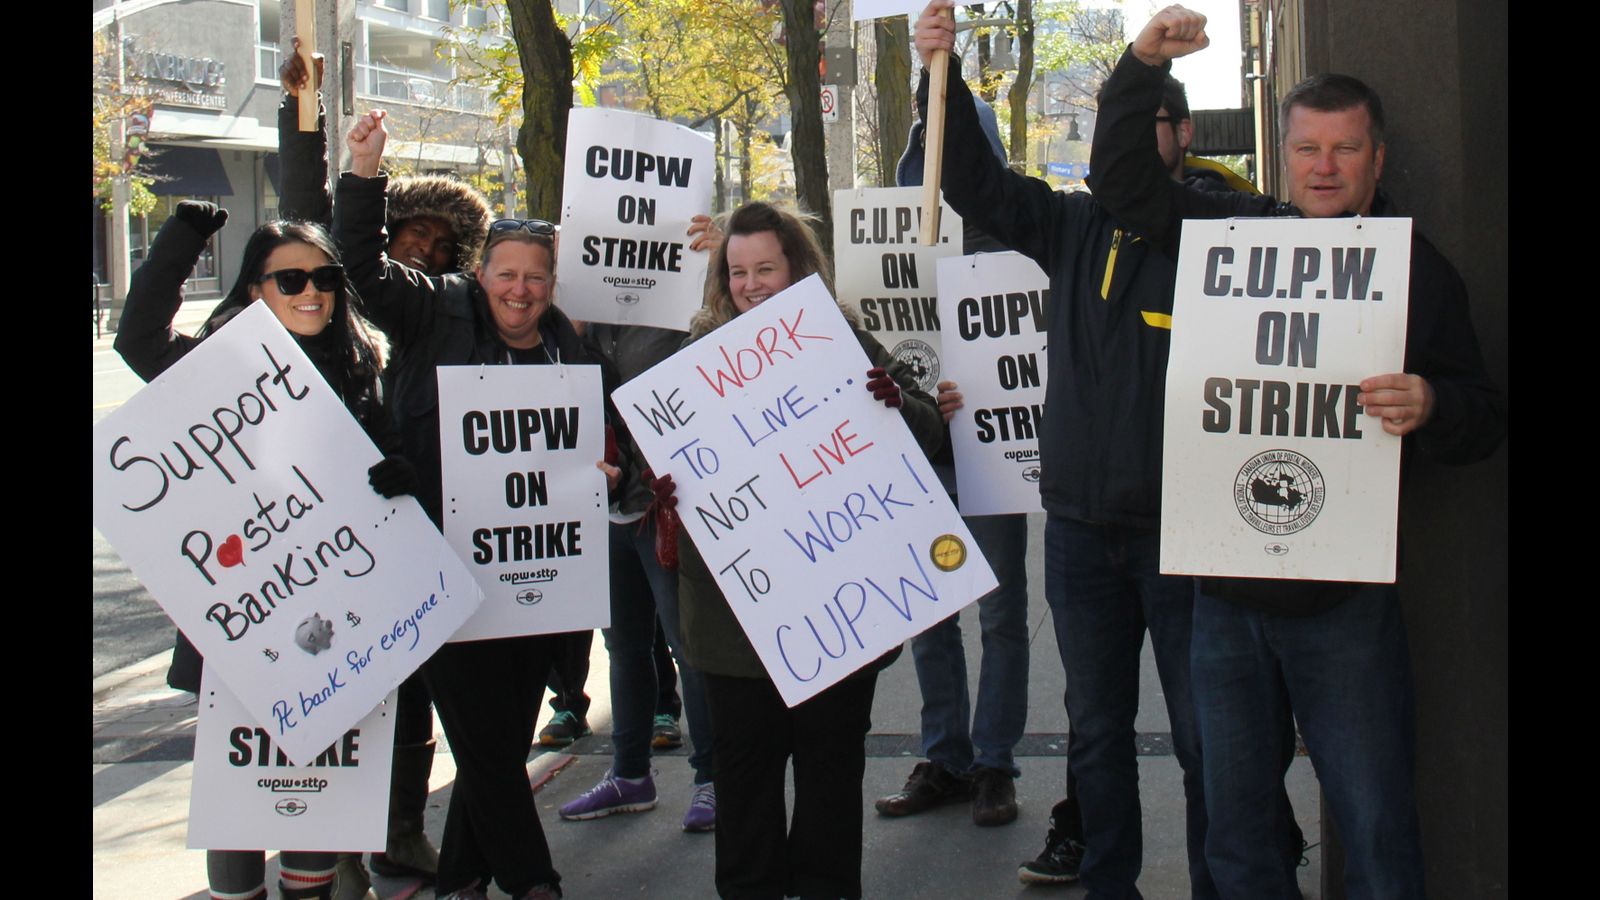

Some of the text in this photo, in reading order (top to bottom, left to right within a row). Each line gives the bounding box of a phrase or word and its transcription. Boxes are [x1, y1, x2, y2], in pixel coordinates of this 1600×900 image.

[586, 145, 692, 188] CUPW
[617, 195, 656, 226] ON
[582, 236, 683, 272] STRIKE
[881, 252, 919, 289] ON
[1203, 246, 1383, 301] C.U.P.W.
[860, 297, 941, 332] STRIK
[1255, 311, 1320, 368] ON
[633, 387, 696, 437] WE
[696, 308, 833, 398] WORK
[997, 354, 1041, 390] ON
[110, 343, 310, 512] Support
[974, 403, 1045, 443] STRI
[1202, 377, 1364, 440] STRIKE
[462, 407, 580, 456] CUPW
[505, 471, 548, 509] ON
[695, 419, 875, 540] NOT LIVE
[472, 521, 583, 565] STRIKE
[776, 543, 939, 682] CUPW
[299, 668, 346, 717] bank
[347, 646, 374, 674] for
[380, 570, 450, 651] everyone!
[229, 726, 360, 767] STE
